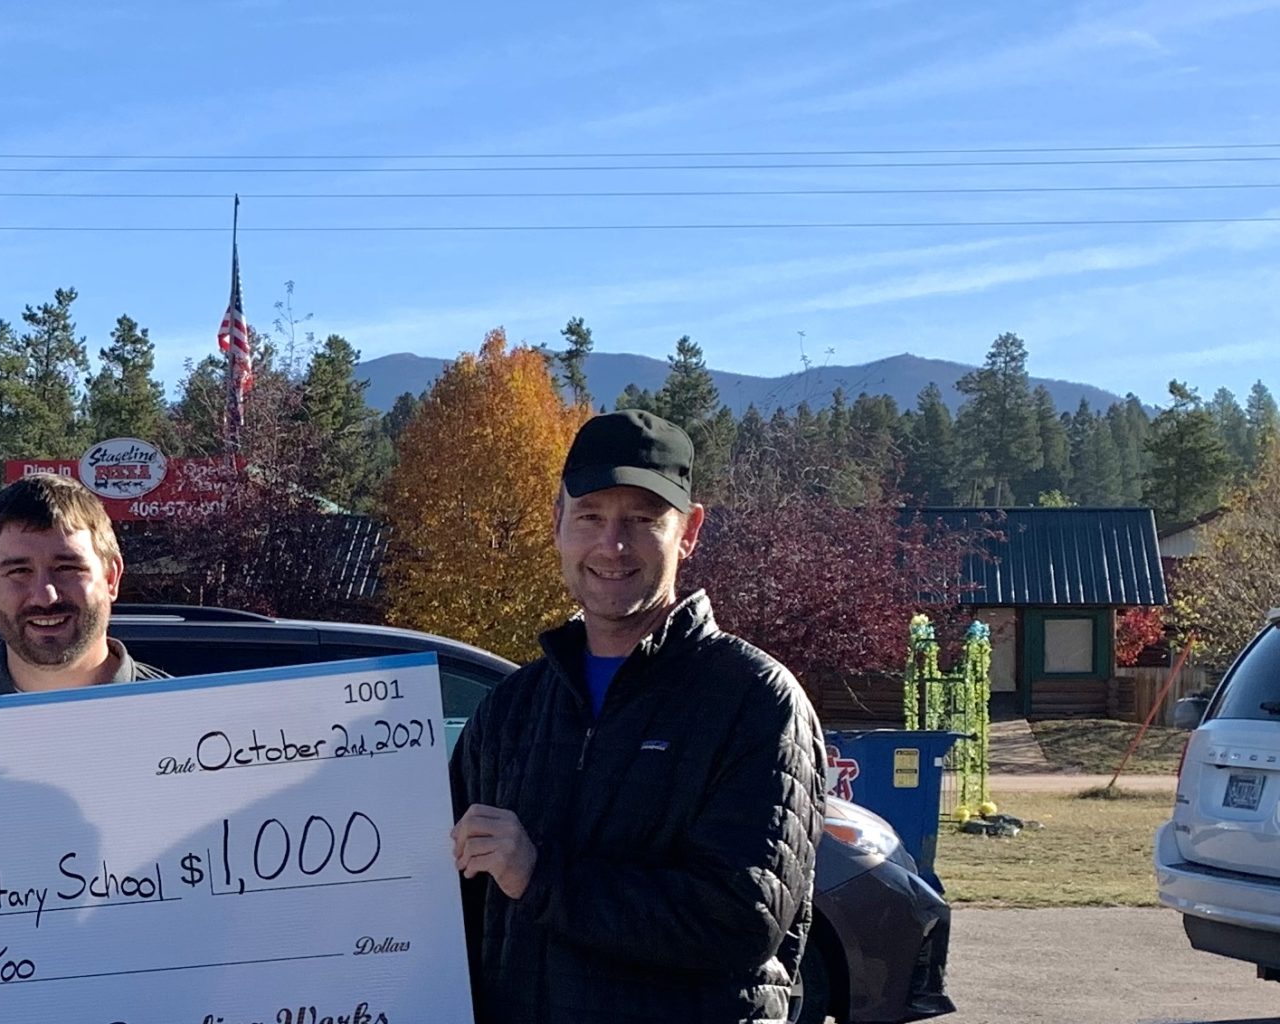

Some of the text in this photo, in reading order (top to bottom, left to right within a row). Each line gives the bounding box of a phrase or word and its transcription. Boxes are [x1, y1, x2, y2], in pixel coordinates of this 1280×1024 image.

[88, 445, 158, 468] Stageline
[344, 679, 404, 703] 1001
[196, 729, 326, 771] October
[156, 756, 196, 776] Date
[58, 852, 165, 901] School
[352, 936, 411, 956] Dollars
